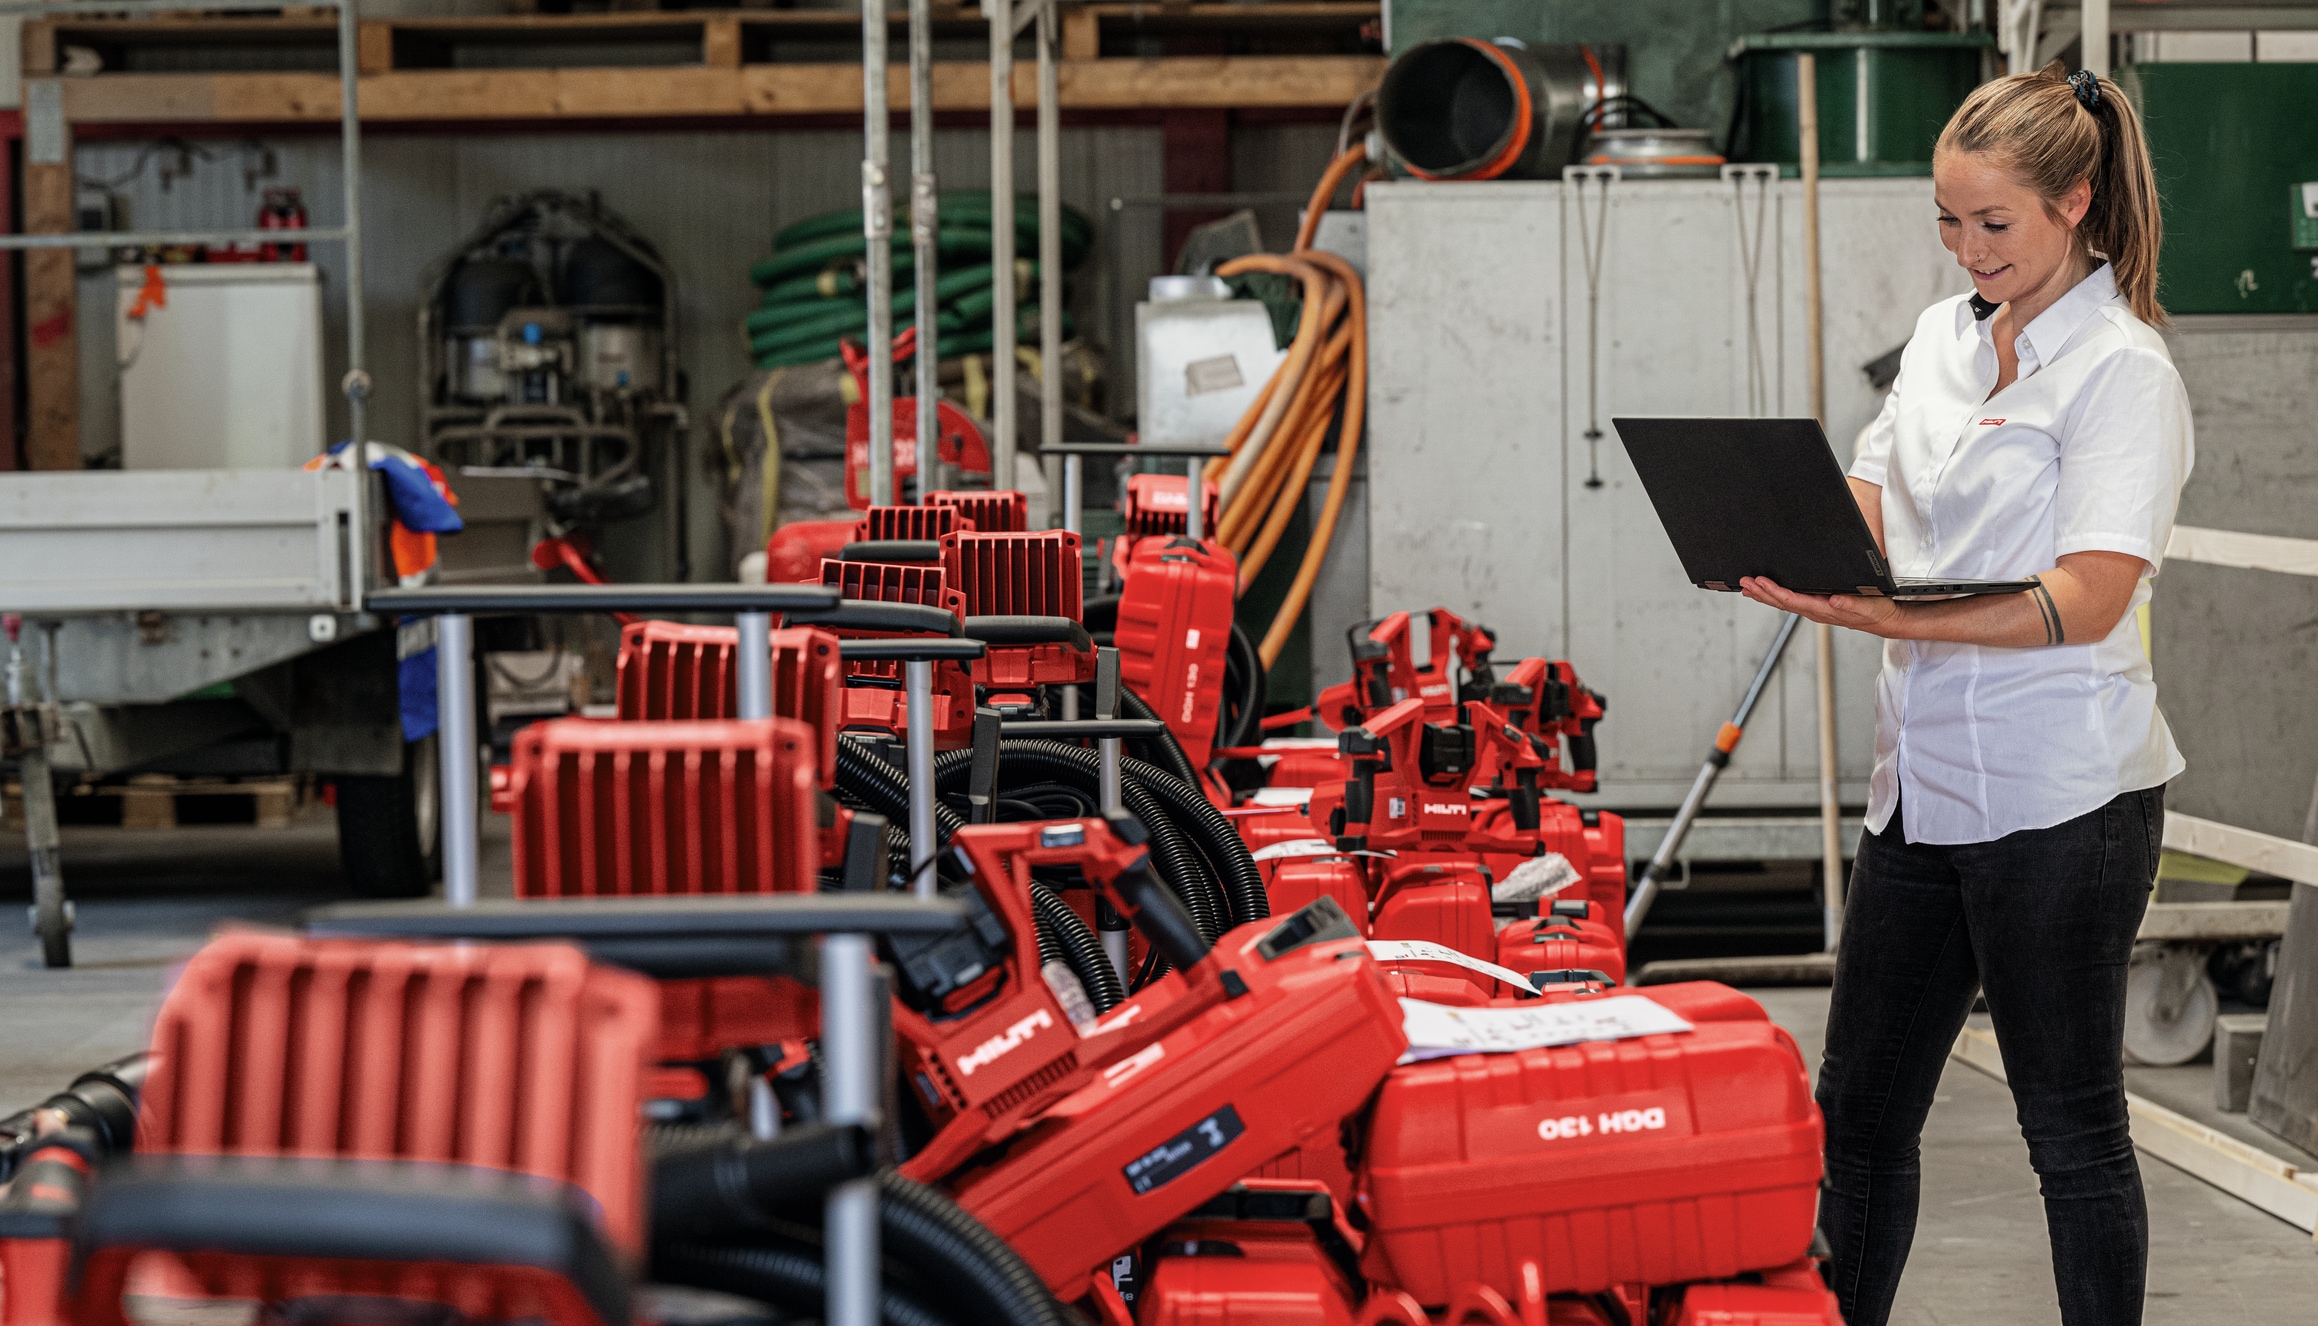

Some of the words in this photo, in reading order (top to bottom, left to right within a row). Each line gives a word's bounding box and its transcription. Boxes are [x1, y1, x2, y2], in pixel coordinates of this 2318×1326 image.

[1424, 803, 1467, 816] HILTI
[957, 1008, 1053, 1076] HILTI
[1537, 1115, 1593, 1141] 130
[1598, 1106, 1666, 1134] DGH
